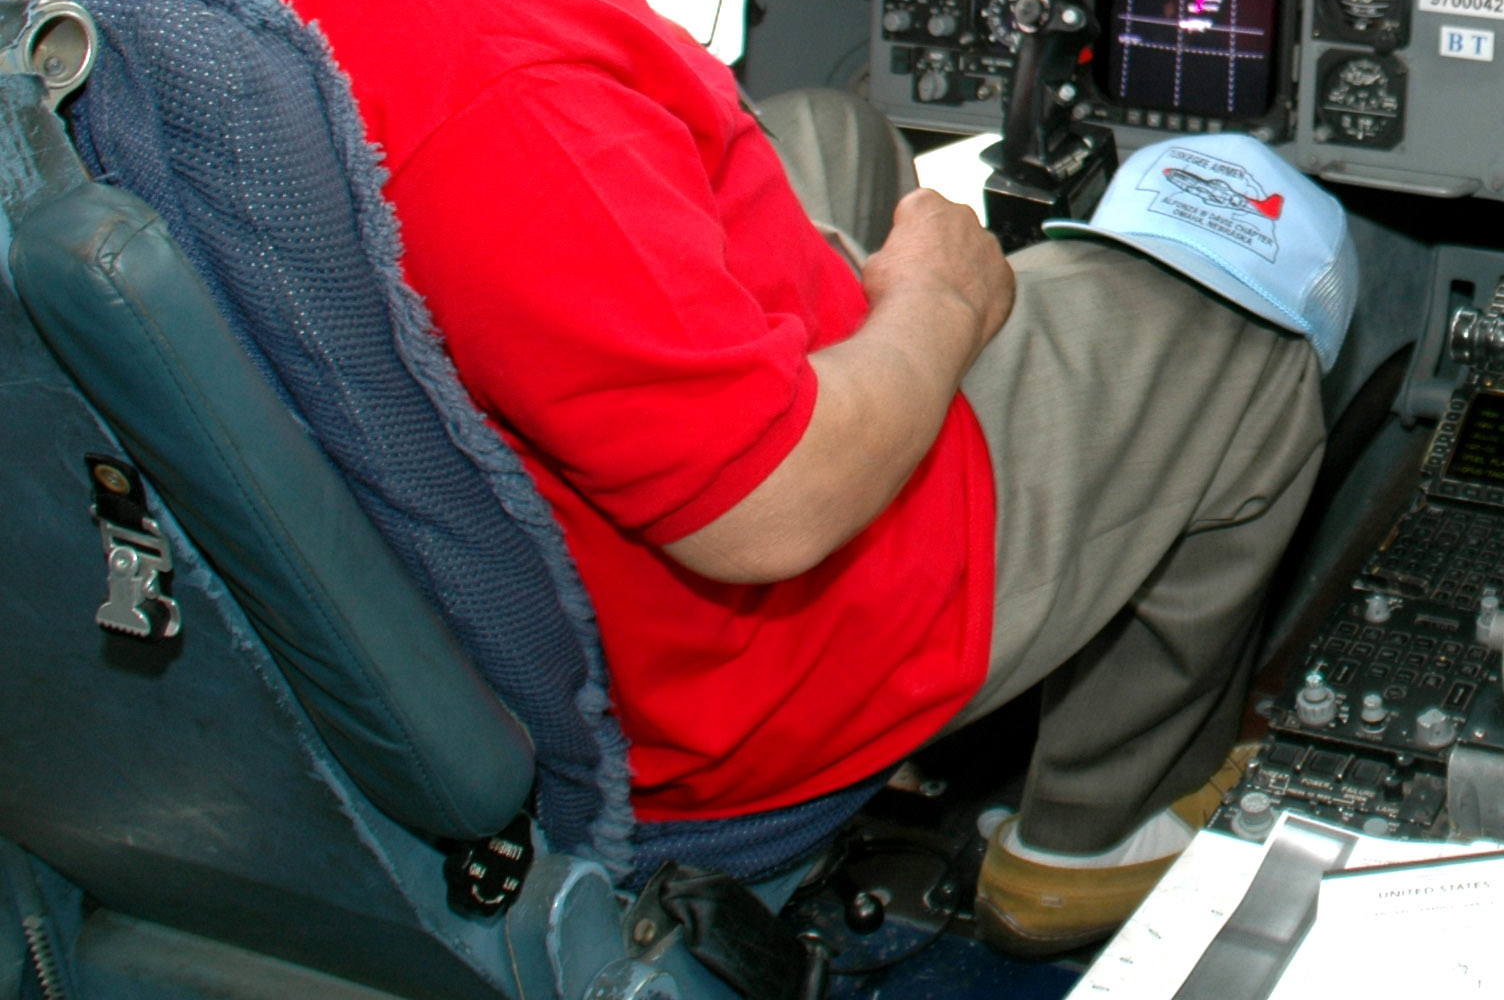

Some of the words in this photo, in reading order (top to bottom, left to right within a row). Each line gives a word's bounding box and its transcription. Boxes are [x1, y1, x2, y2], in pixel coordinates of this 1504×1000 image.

[1210, 163, 1245, 180] AIRMEN
[1207, 220, 1254, 245] NEBRASKA
[1379, 887, 1434, 899] UNITED
[1440, 881, 1490, 893] STATES
